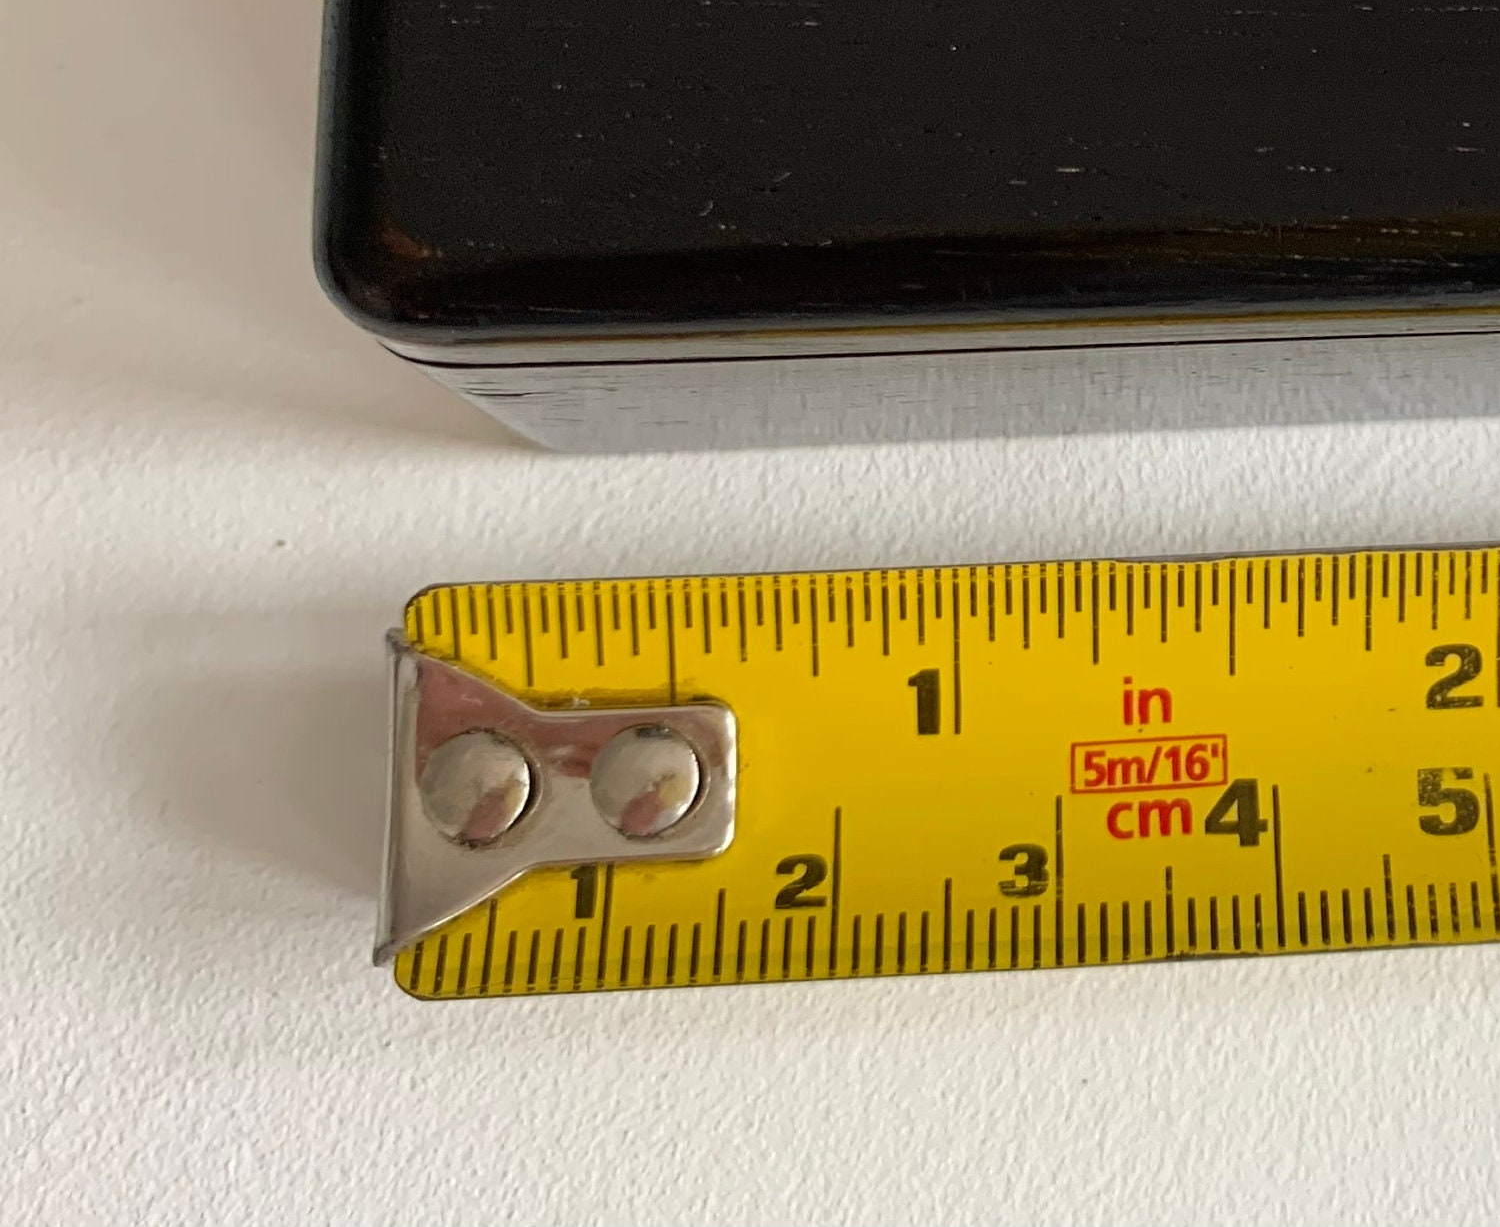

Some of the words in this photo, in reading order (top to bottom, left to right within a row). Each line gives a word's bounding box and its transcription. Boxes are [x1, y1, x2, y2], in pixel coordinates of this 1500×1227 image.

[908, 669, 941, 735] 1
[1122, 676, 1173, 725] in
[1424, 644, 1484, 709] 2
[1106, 796, 1193, 839] cm
[1204, 778, 1268, 847] 4
[1417, 767, 1480, 836] 5
[774, 854, 829, 910] 2
[998, 843, 1051, 898] 3
